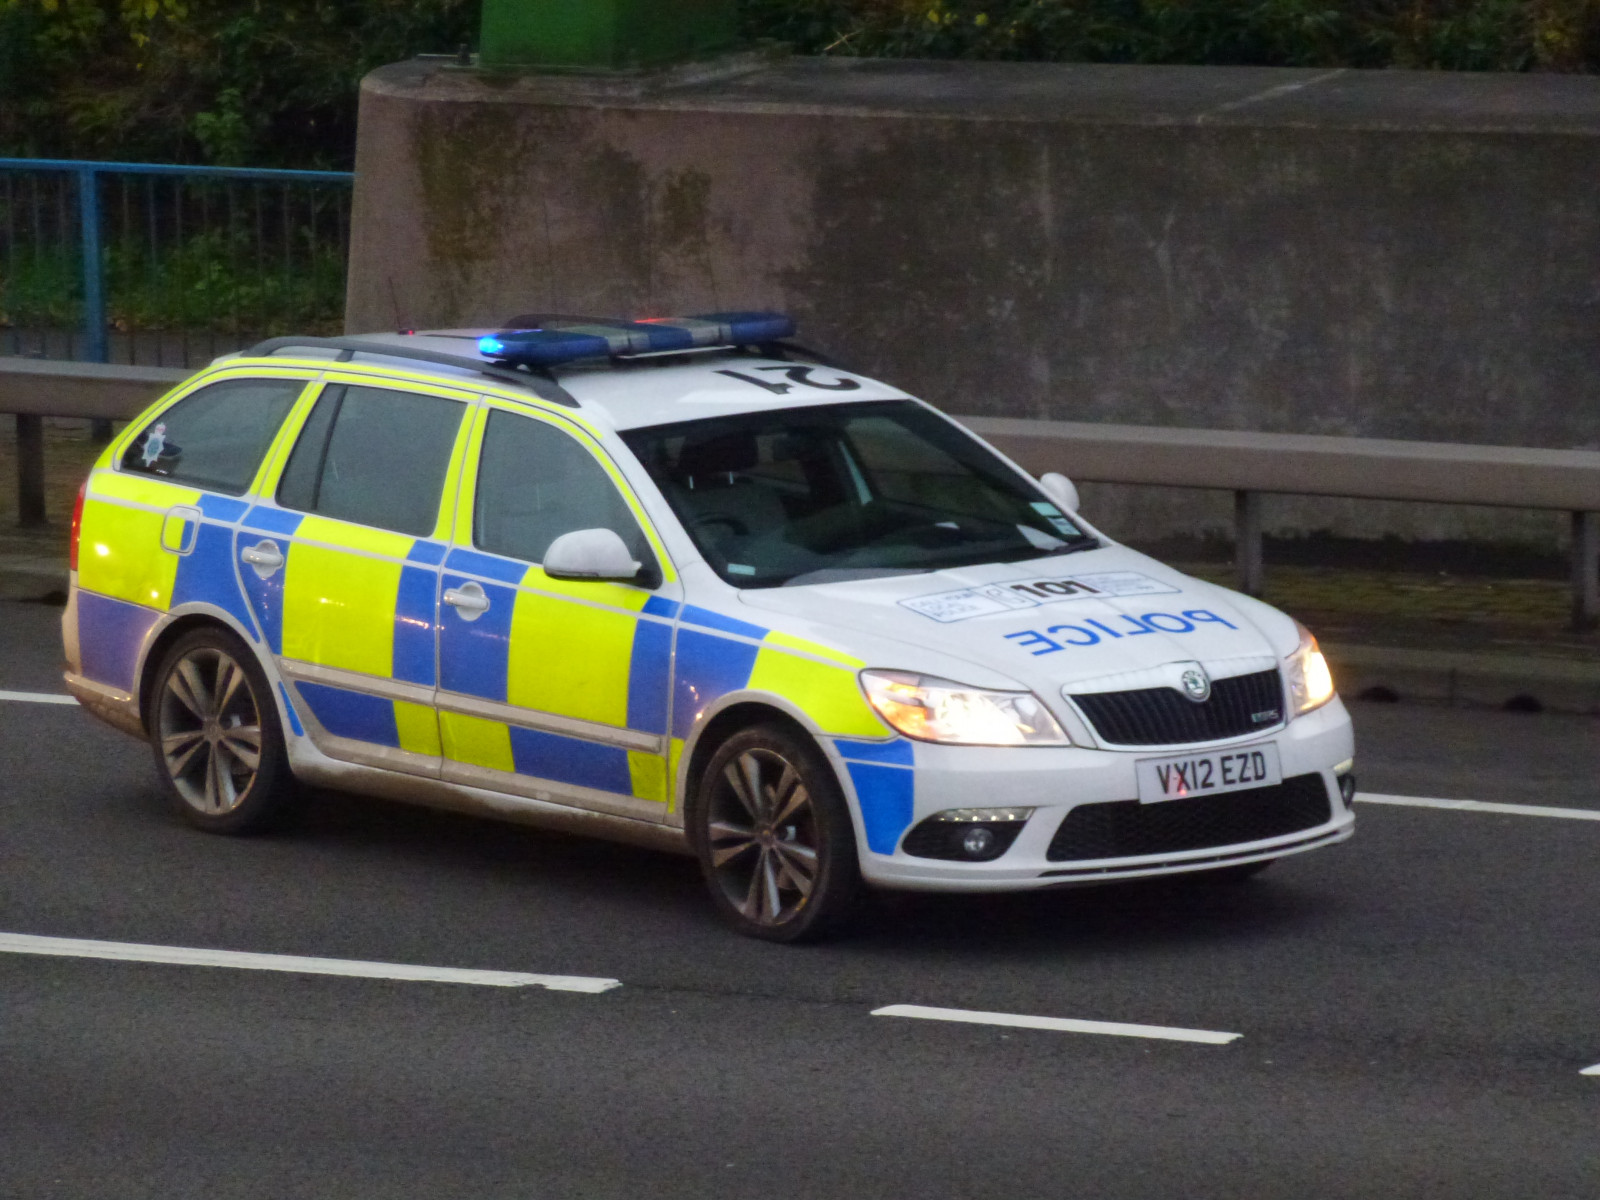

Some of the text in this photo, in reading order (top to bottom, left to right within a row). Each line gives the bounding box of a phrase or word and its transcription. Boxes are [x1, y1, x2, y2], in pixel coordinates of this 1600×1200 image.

[1010, 577, 1102, 598] 101
[1156, 751, 1266, 794] VX12 EZD
